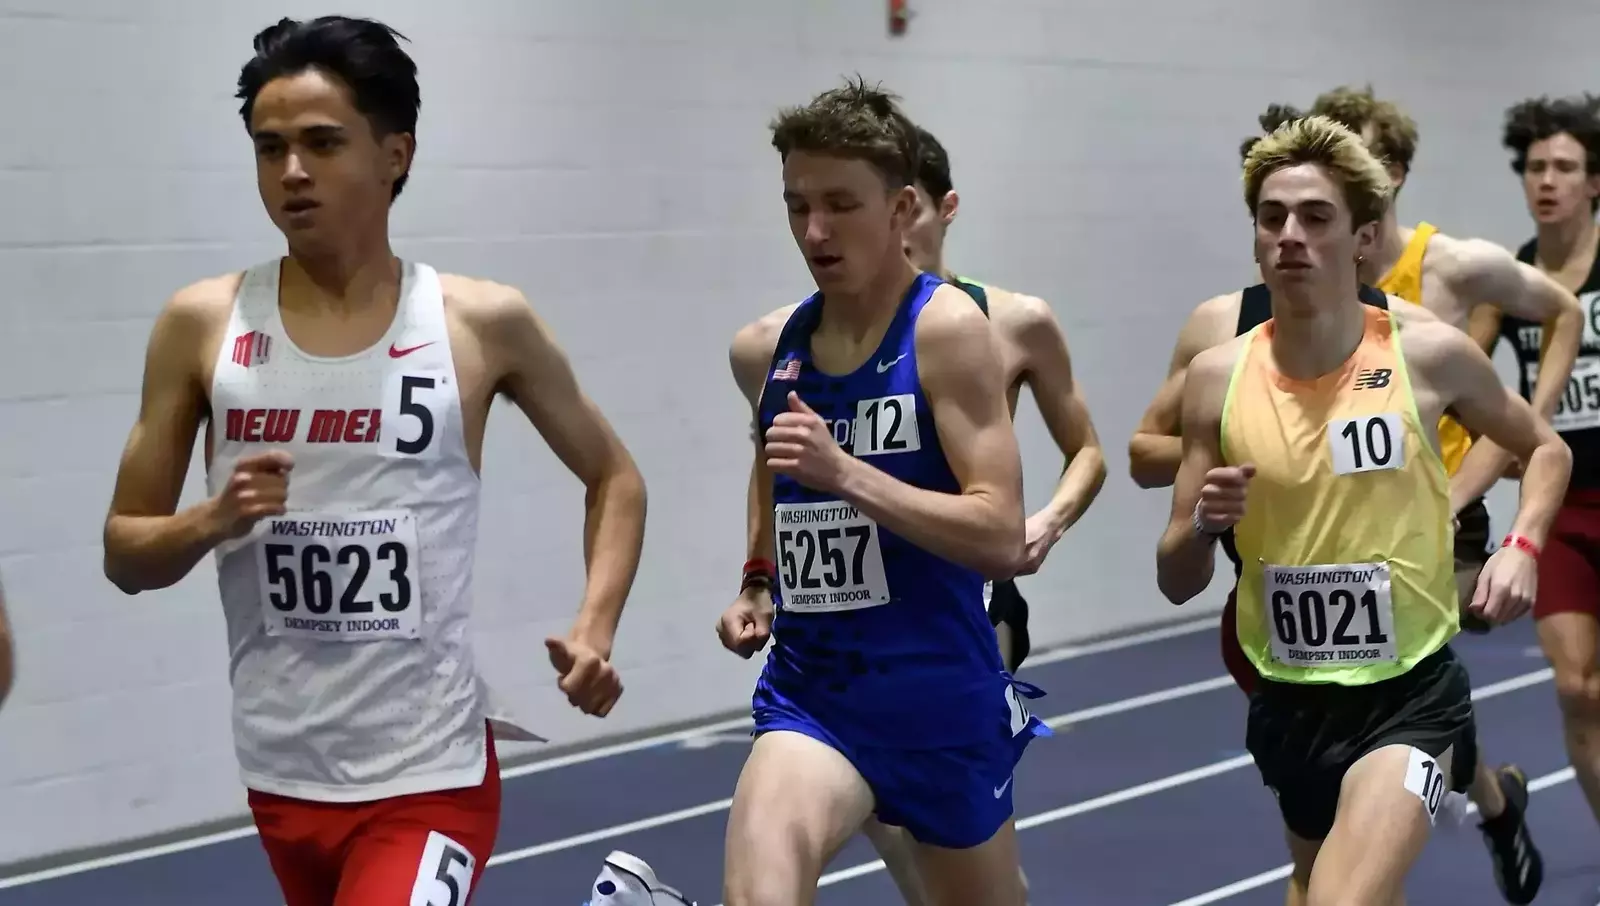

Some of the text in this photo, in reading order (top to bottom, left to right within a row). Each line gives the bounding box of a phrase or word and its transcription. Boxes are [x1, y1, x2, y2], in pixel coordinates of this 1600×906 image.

[226, 409, 301, 442] NEW
[396, 375, 435, 454] 5
[865, 399, 907, 451] 12
[1341, 417, 1392, 468] 10
[271, 518, 397, 538] WASHINGTON
[781, 506, 859, 524] WASHINGTON
[265, 541, 411, 614] 5623
[779, 525, 871, 590] 5257
[1274, 570, 1374, 586] WASHINGTON
[791, 590, 871, 605] DEMPSEY INDOOR
[1271, 589, 1388, 647] 6021
[284, 617, 400, 633] DEMPSEY INDOOR
[1288, 649, 1381, 661] DEMPSEY INDOOR
[1421, 760, 1443, 815] 10
[427, 844, 468, 906] 5
